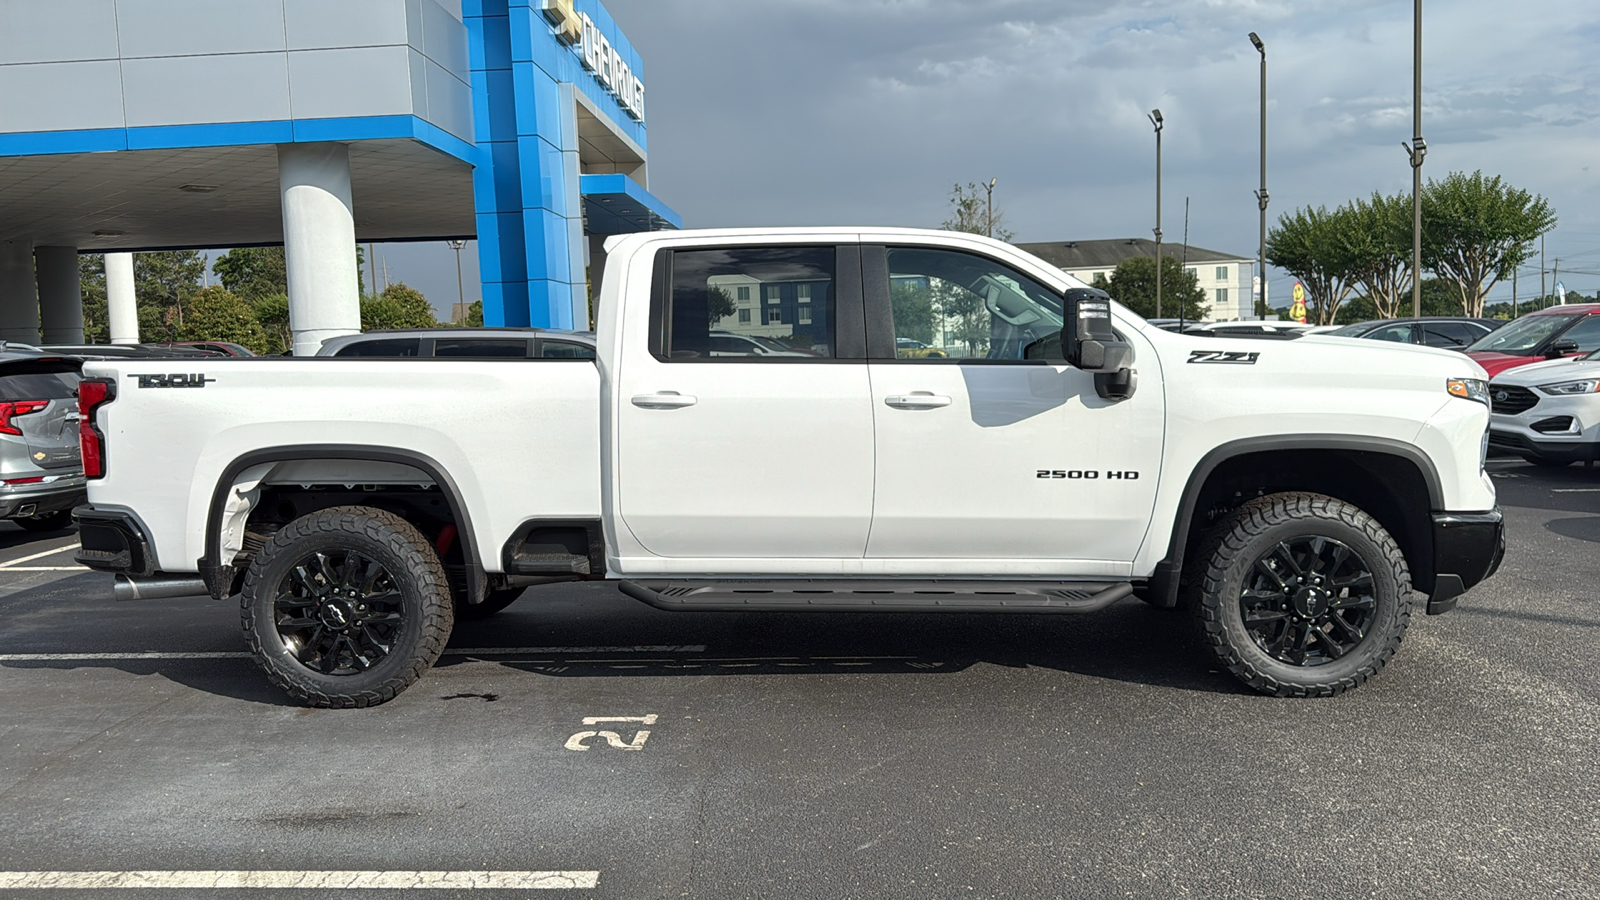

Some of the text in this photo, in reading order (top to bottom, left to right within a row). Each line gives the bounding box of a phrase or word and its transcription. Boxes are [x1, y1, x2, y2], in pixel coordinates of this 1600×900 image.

[581, 11, 645, 122] CHEVROLET
[1186, 350, 1260, 364] Z71
[1036, 469, 1139, 480] 2500 HD
[564, 713, 658, 752] 21
